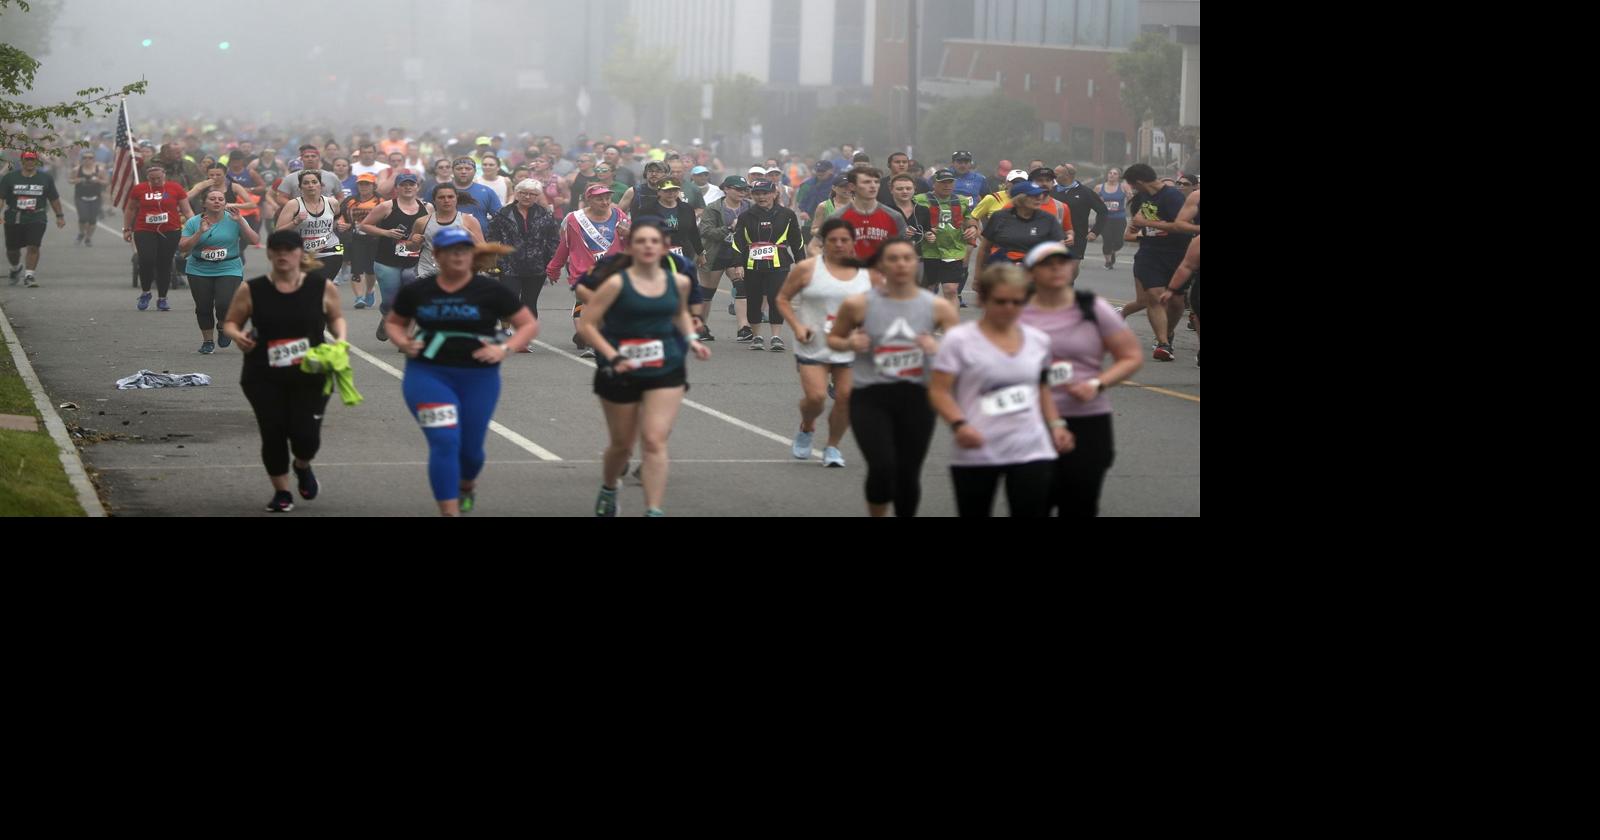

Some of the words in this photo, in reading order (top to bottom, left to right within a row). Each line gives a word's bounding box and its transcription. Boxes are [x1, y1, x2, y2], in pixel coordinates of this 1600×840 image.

[144, 192, 169, 200] USA
[305, 238, 327, 249] 2874
[205, 250, 226, 259] 4018
